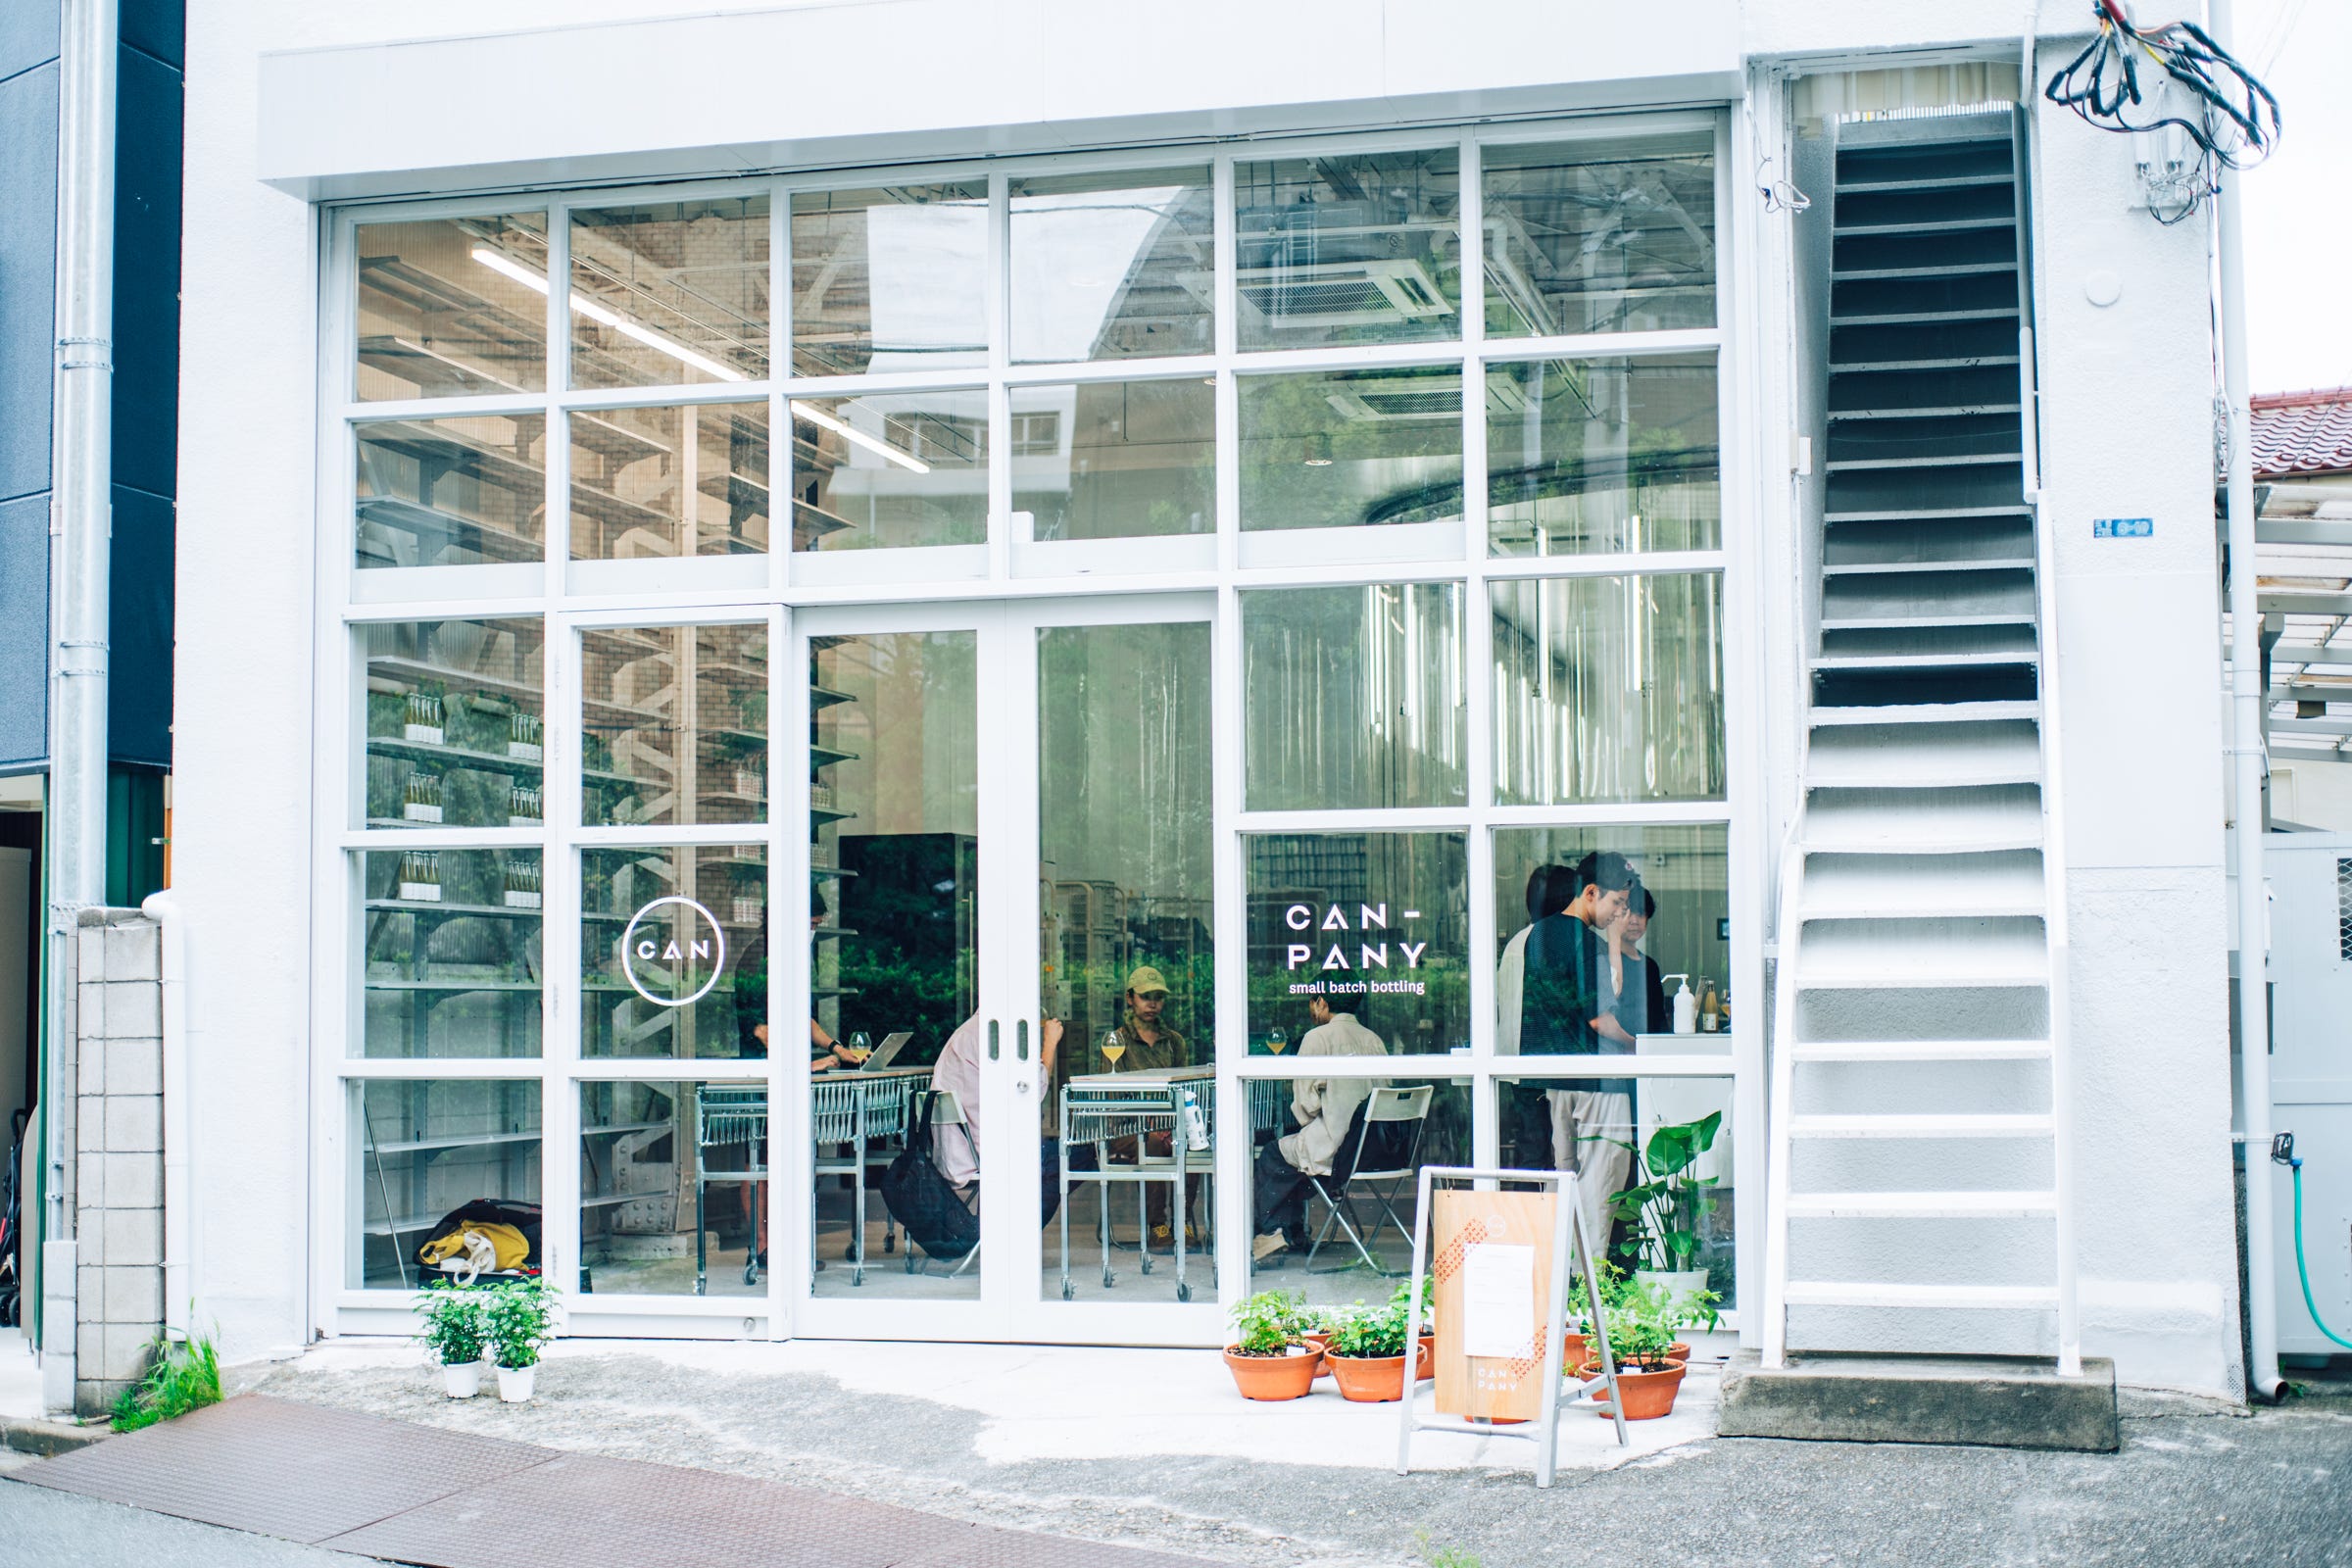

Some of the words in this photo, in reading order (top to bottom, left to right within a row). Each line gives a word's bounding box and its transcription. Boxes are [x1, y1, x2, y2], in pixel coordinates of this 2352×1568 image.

[637, 940, 710, 960] CAN
[1287, 943, 1427, 970] PANY
[1289, 981, 1326, 994] small
[1329, 981, 1367, 994] batch
[1371, 980, 1425, 996] bottling
[1478, 1380, 1517, 1392] PANY
